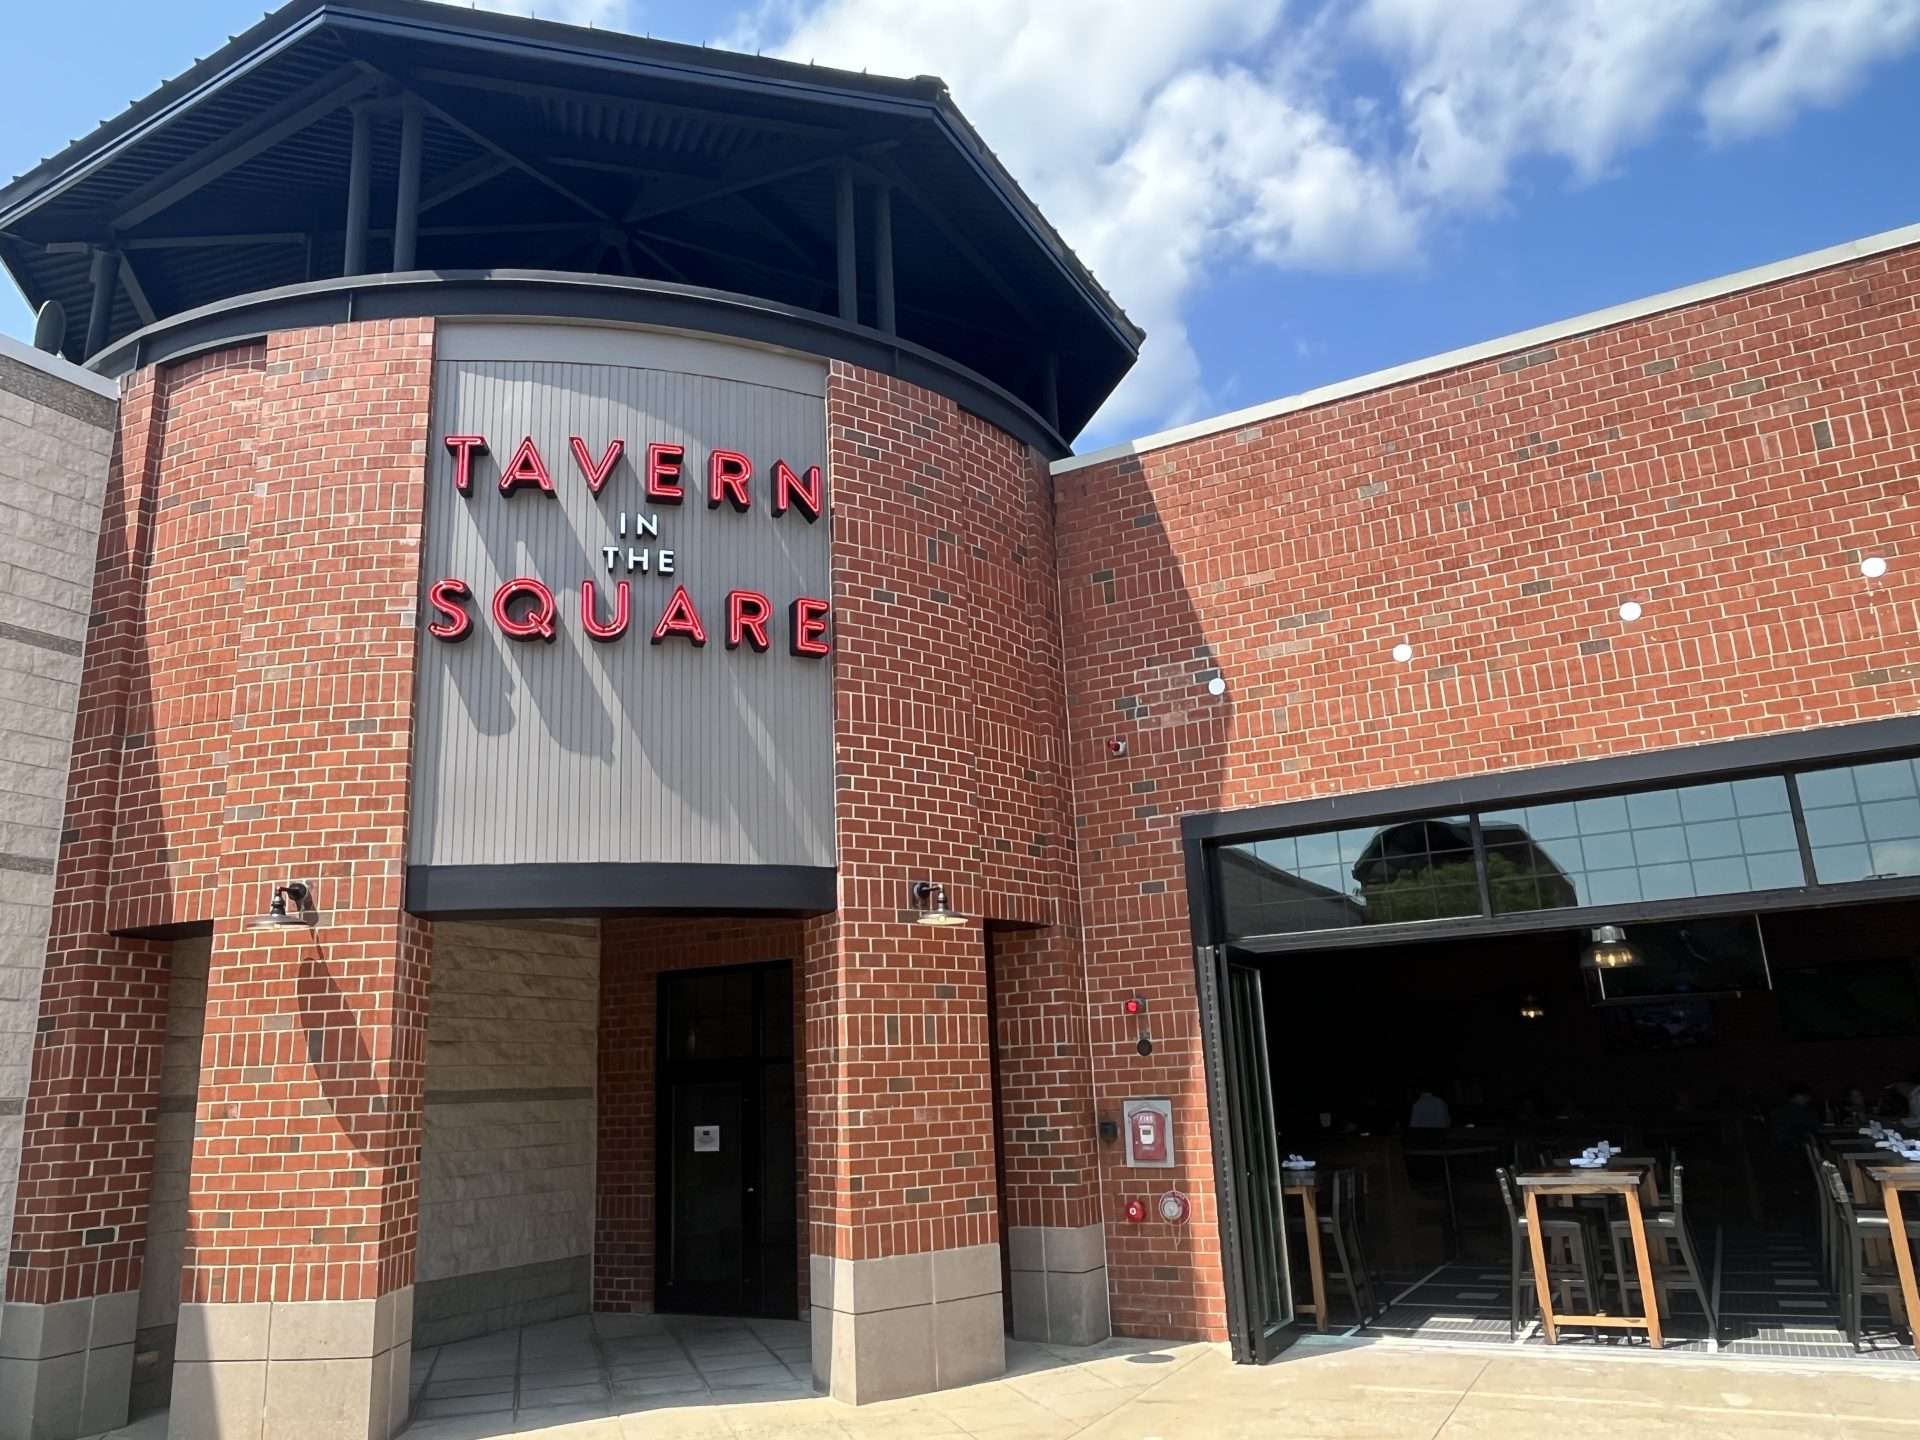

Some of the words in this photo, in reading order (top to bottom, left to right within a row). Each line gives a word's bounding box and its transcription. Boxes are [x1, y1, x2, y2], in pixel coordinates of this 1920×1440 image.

[444, 435, 822, 524] TAVERN
[620, 512, 659, 539] IN
[602, 546, 675, 577] THE
[428, 577, 831, 659] SQUARE
